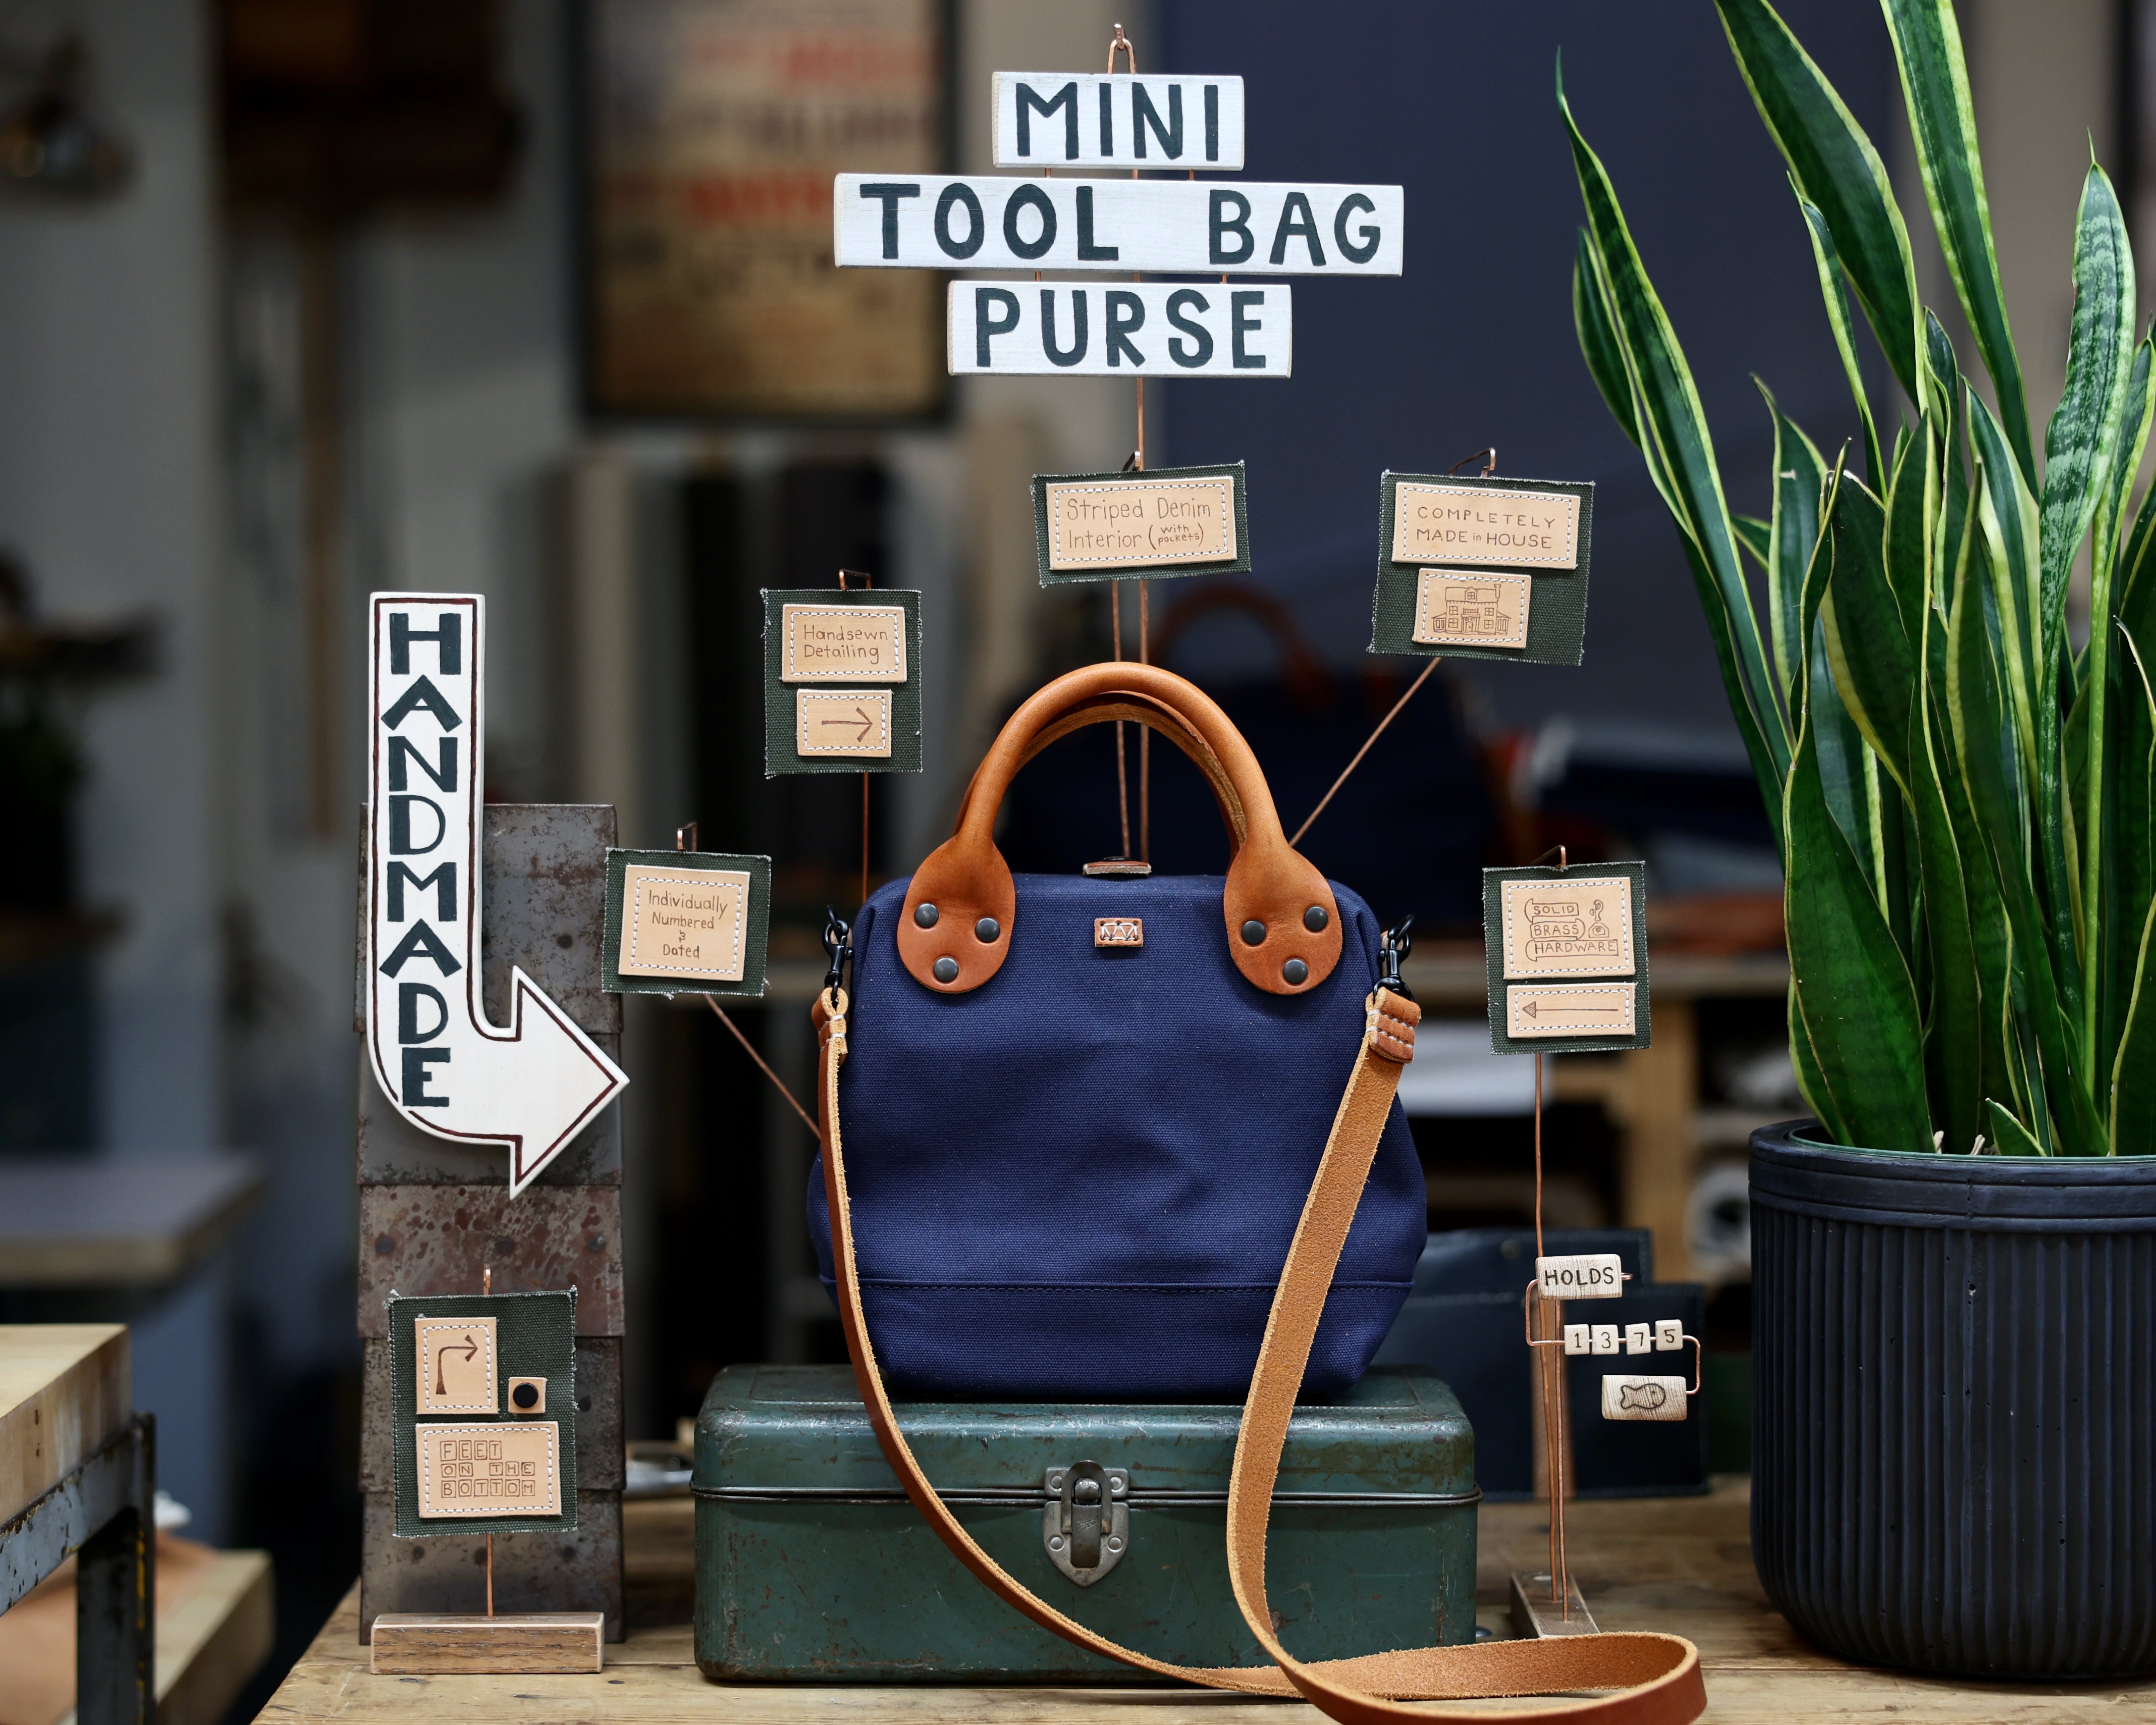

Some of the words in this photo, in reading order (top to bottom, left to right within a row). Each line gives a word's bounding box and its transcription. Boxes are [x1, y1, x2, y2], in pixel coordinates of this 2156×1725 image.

[1014, 81, 1219, 162] MINI
[859, 182, 1119, 262] TOOL
[1209, 189, 1382, 266] BAG
[976, 287, 1267, 369] PURSE
[1067, 499, 1144, 528] Striped
[1157, 498, 1210, 519] Denim
[1417, 507, 1555, 529] COMPLETELY
[1068, 529, 1142, 549] Interior
[1417, 529, 1468, 543] MADE
[1473, 533, 1481, 542] in
[1486, 533, 1552, 549] HOUSE
[804, 625, 888, 641] Handsewn
[804, 644, 879, 664] Detailing
[379, 612, 463, 1108] HANDMADE
[649, 890, 728, 920] Individually
[1534, 905, 1575, 915] SOLID
[652, 911, 714, 929] Numbered
[1534, 925, 1579, 936] BRASS
[663, 944, 699, 959] Dated
[1535, 941, 1615, 954] HARDWARE
[1545, 1267, 1614, 1286] HOLDS
[444, 1443, 500, 1459] FEET
[444, 1465, 470, 1475] ON
[492, 1463, 535, 1475] THE
[444, 1481, 533, 1496] BOTTOM
